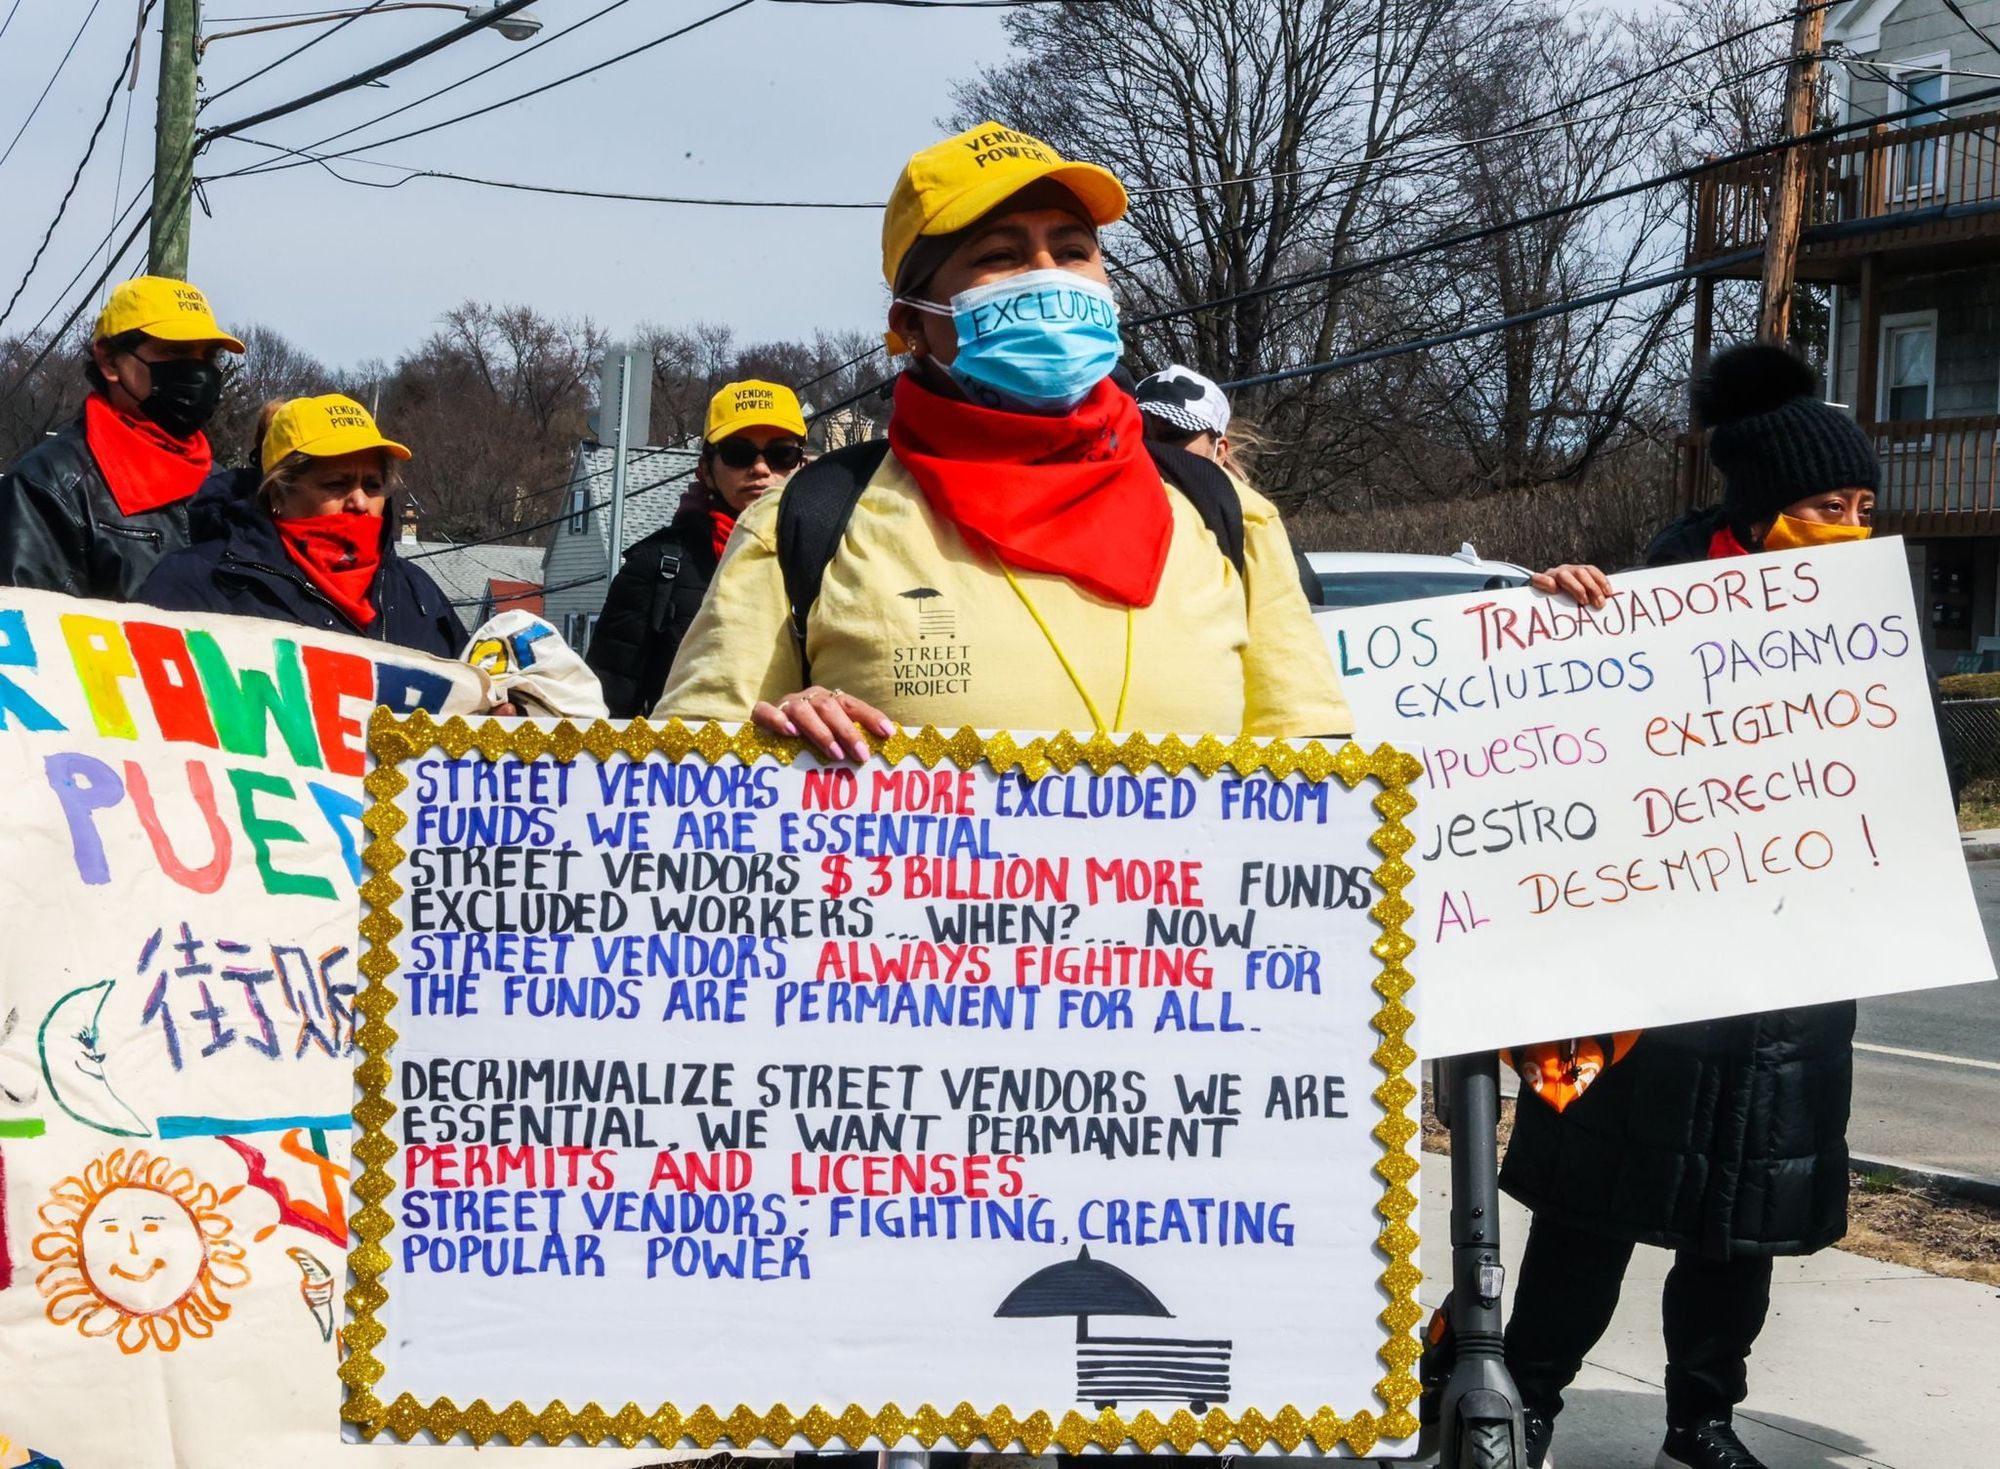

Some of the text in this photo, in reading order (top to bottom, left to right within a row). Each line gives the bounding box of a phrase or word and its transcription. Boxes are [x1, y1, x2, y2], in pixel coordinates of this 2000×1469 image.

[972, 290, 1114, 338] EXCLUDED
[735, 389, 773, 400] VENDOR
[894, 646, 970, 662] STREET
[894, 662, 971, 679] VENDOR
[1338, 619, 1437, 676] LOS
[1691, 615, 1909, 704] PAGAMOS
[894, 679, 971, 697] PROJECT
[416, 758, 1328, 824] STREET VENDORS NO MORE EXCLUDED FROM
[1633, 759, 1856, 837] DERECHO
[587, 811, 649, 851] WE
[675, 812, 756, 853] ARE
[409, 846, 581, 891] STREET
[600, 851, 801, 895] VENDORS
[903, 856, 1068, 900] BILLION
[1085, 858, 1204, 907] MORE
[1240, 861, 1373, 910] FUNDS
[1436, 891, 1490, 943] AL
[1518, 832, 1833, 914] DESEMPLEO
[410, 888, 629, 933] EXCLUDED
[411, 932, 1322, 995] STREET VENDORS ALWAYS FIGHTING FOR
[403, 972, 481, 1017] THE
[504, 975, 642, 1021] FUNDS
[662, 979, 749, 1024] ARE
[775, 980, 1041, 1030] PERMANENT
[1058, 988, 1134, 1031] FOR
[401, 1058, 1349, 1120] DECRIMINALIZE STREET VENDORS WE ARE
[698, 1110, 768, 1151] WE
[795, 1112, 942, 1152] WANT
[967, 1115, 1238, 1160] PERMANENT
[404, 1143, 616, 1191] PERMITS
[648, 1149, 753, 1194] AND
[401, 1188, 566, 1235] STREET
[1079, 1198, 1295, 1247] CREATING
[403, 1232, 811, 1281] POPULAR POWER
